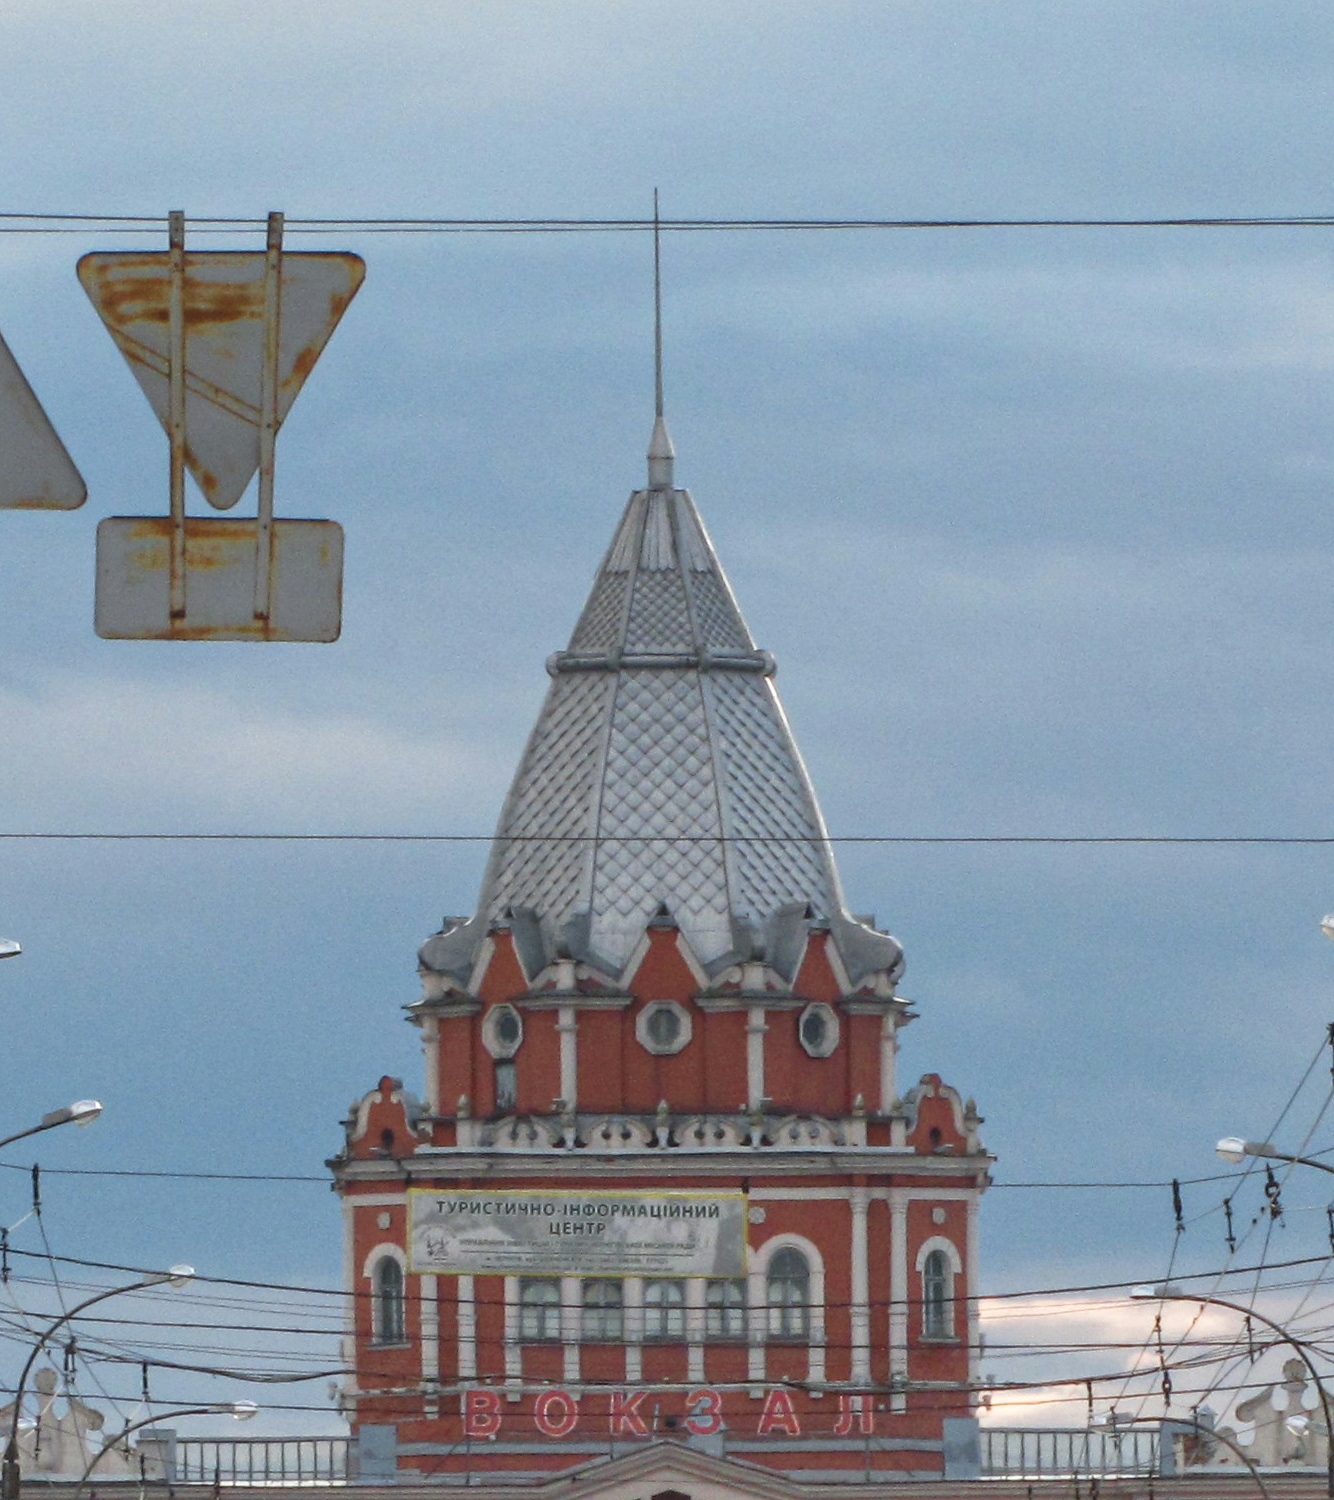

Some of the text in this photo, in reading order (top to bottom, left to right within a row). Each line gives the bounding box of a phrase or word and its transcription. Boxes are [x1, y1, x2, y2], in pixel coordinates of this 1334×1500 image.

[436, 1200, 720, 1219] ТУРИСТИЧНО-ІНФОРМАЦІЙНИЙ
[549, 1222, 605, 1236] ЦЕНТР
[464, 1389, 874, 1437] ВОКЗАЛ
